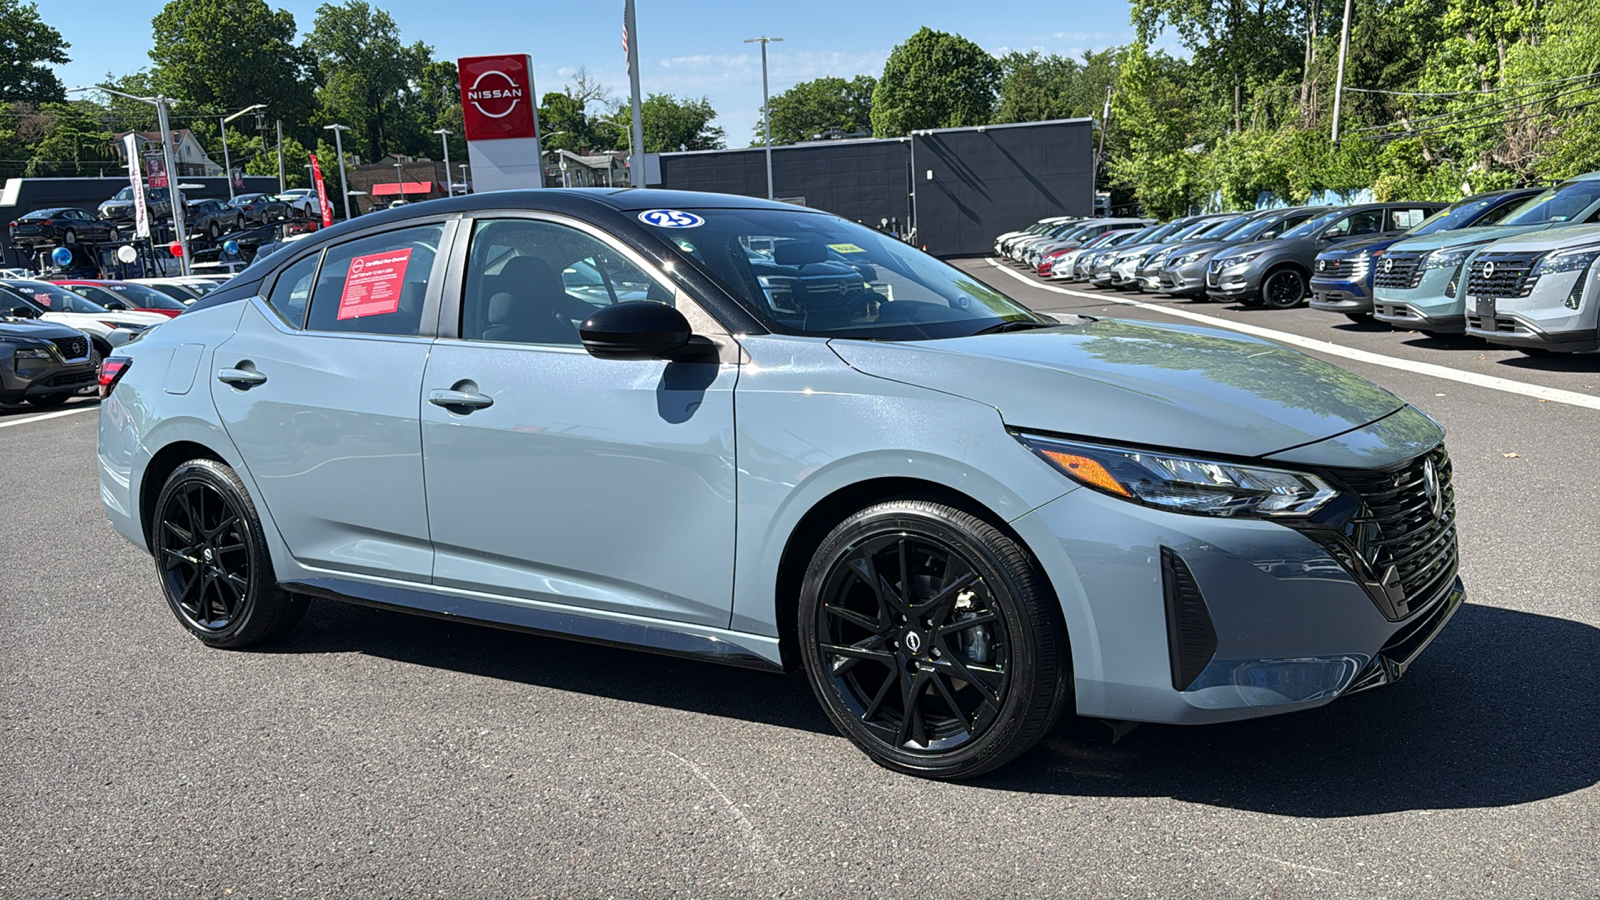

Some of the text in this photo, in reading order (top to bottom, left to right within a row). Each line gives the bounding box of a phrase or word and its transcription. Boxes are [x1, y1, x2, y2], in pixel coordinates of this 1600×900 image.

[468, 88, 522, 100] NISSAN
[650, 211, 692, 226] 25
[383, 256, 408, 264] Pre-Owned
